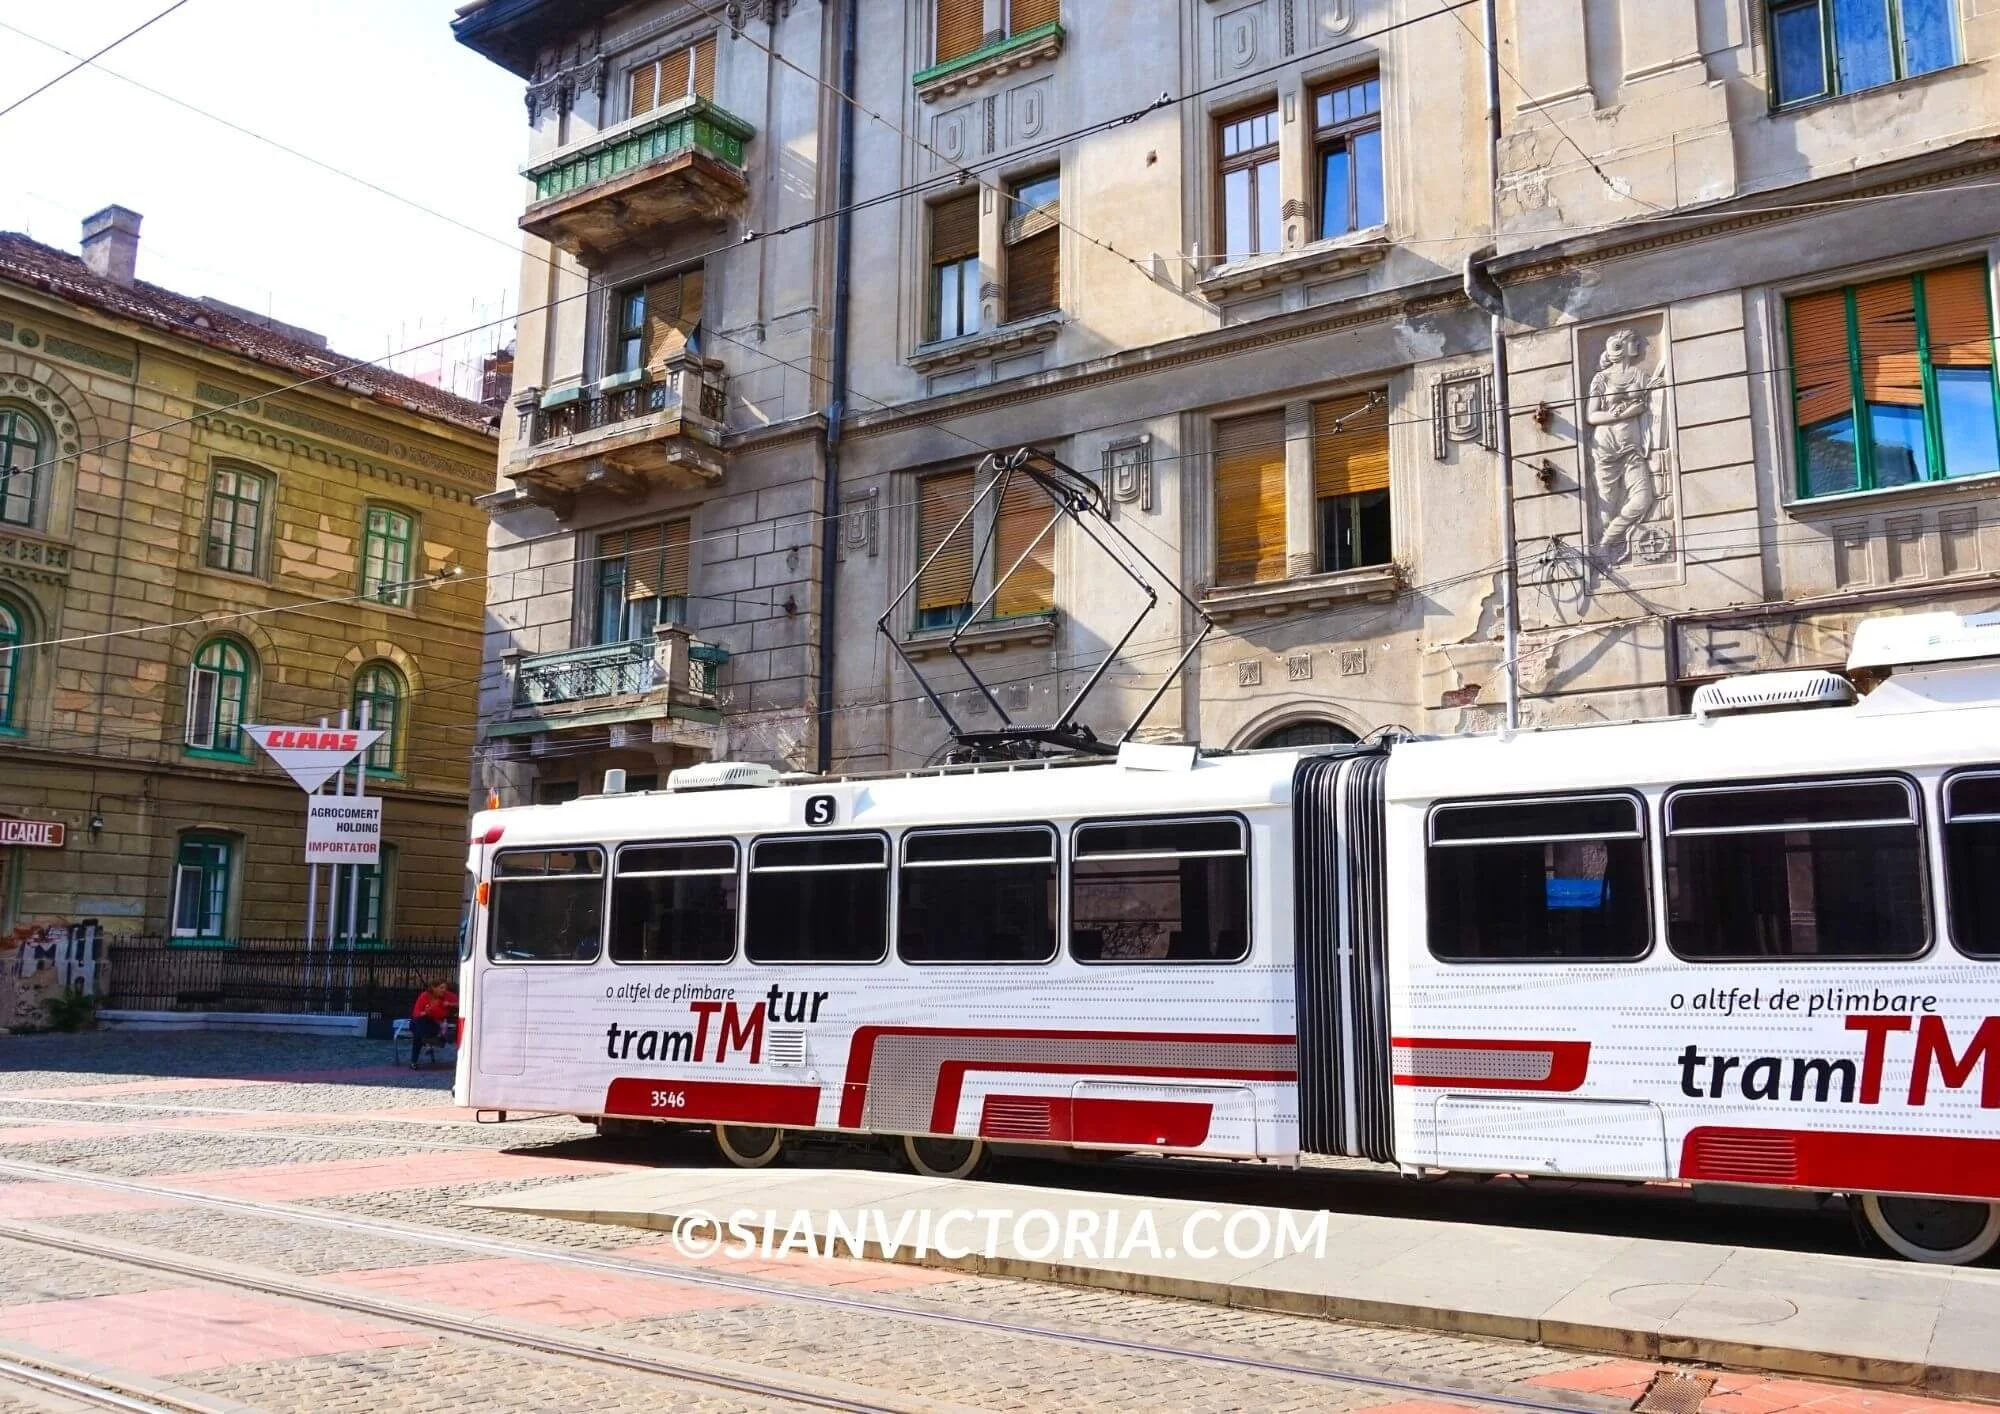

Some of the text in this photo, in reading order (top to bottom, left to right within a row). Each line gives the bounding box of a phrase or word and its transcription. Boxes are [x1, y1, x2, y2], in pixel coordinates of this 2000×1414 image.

[266, 730, 359, 751] CLAAS
[311, 808, 379, 819] AGROCOMERT
[814, 799, 828, 823] S
[337, 823, 378, 833] HOLDING
[309, 842, 377, 853] IMPORTATOR
[606, 984, 735, 1002] o altfel de plimbare
[1670, 987, 1937, 1017] o altfel de plimbare
[651, 1091, 686, 1107] 3546
